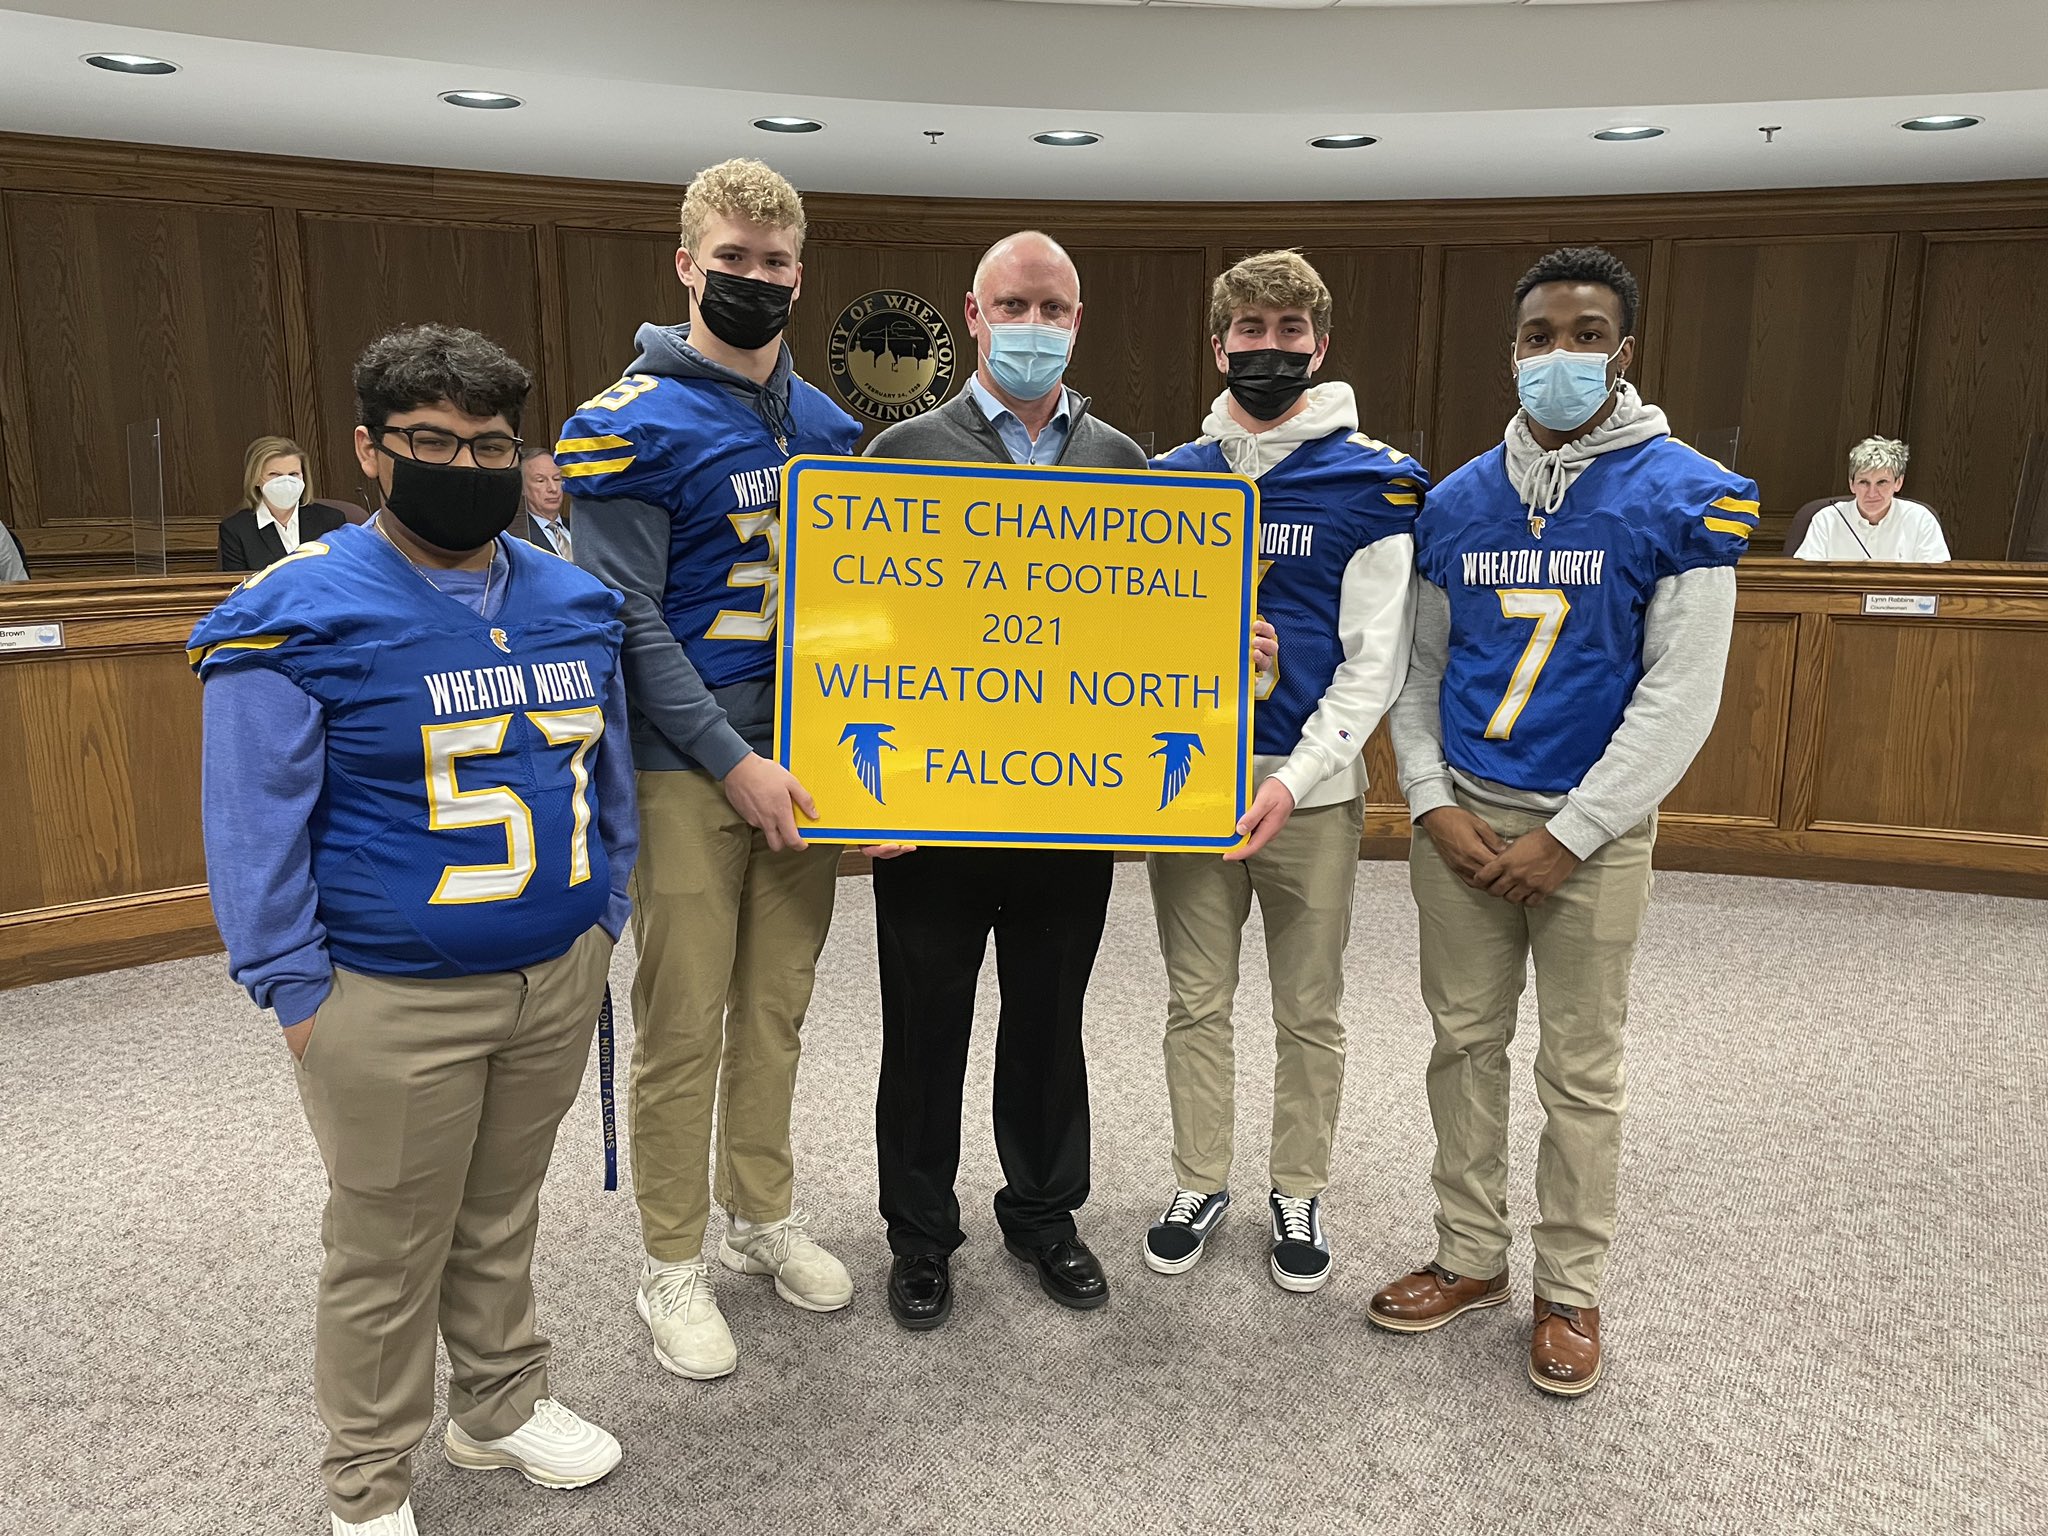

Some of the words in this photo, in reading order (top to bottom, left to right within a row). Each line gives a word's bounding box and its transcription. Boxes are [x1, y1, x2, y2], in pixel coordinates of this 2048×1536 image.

[831, 323, 849, 375] CITY
[850, 297, 874, 320] OF
[883, 294, 953, 379] WHEATON
[846, 391, 937, 420] ILLINOIS
[864, 382, 895, 398] FEBRUARY
[729, 465, 784, 508] WHEAT
[812, 494, 941, 534] STATE
[964, 501, 1232, 547] CHAMPIONS
[832, 554, 943, 588] CLASS
[963, 560, 1007, 590] 7A
[1027, 563, 1207, 598] FOOTBALL
[1461, 549, 1542, 586] WHEATON
[1548, 550, 1605, 586] NORTH
[982, 614, 1062, 645] 2021
[815, 663, 1042, 703] WHEATON
[1070, 671, 1220, 709] NORTH
[1484, 588, 1571, 740] 7
[425, 665, 526, 715] WHEATON
[534, 659, 595, 706] NORTH
[926, 749, 1123, 788] FALCONS
[421, 705, 605, 905] 57
[599, 1037, 611, 1082] NORTH
[602, 1088, 616, 1150] FALCONS
